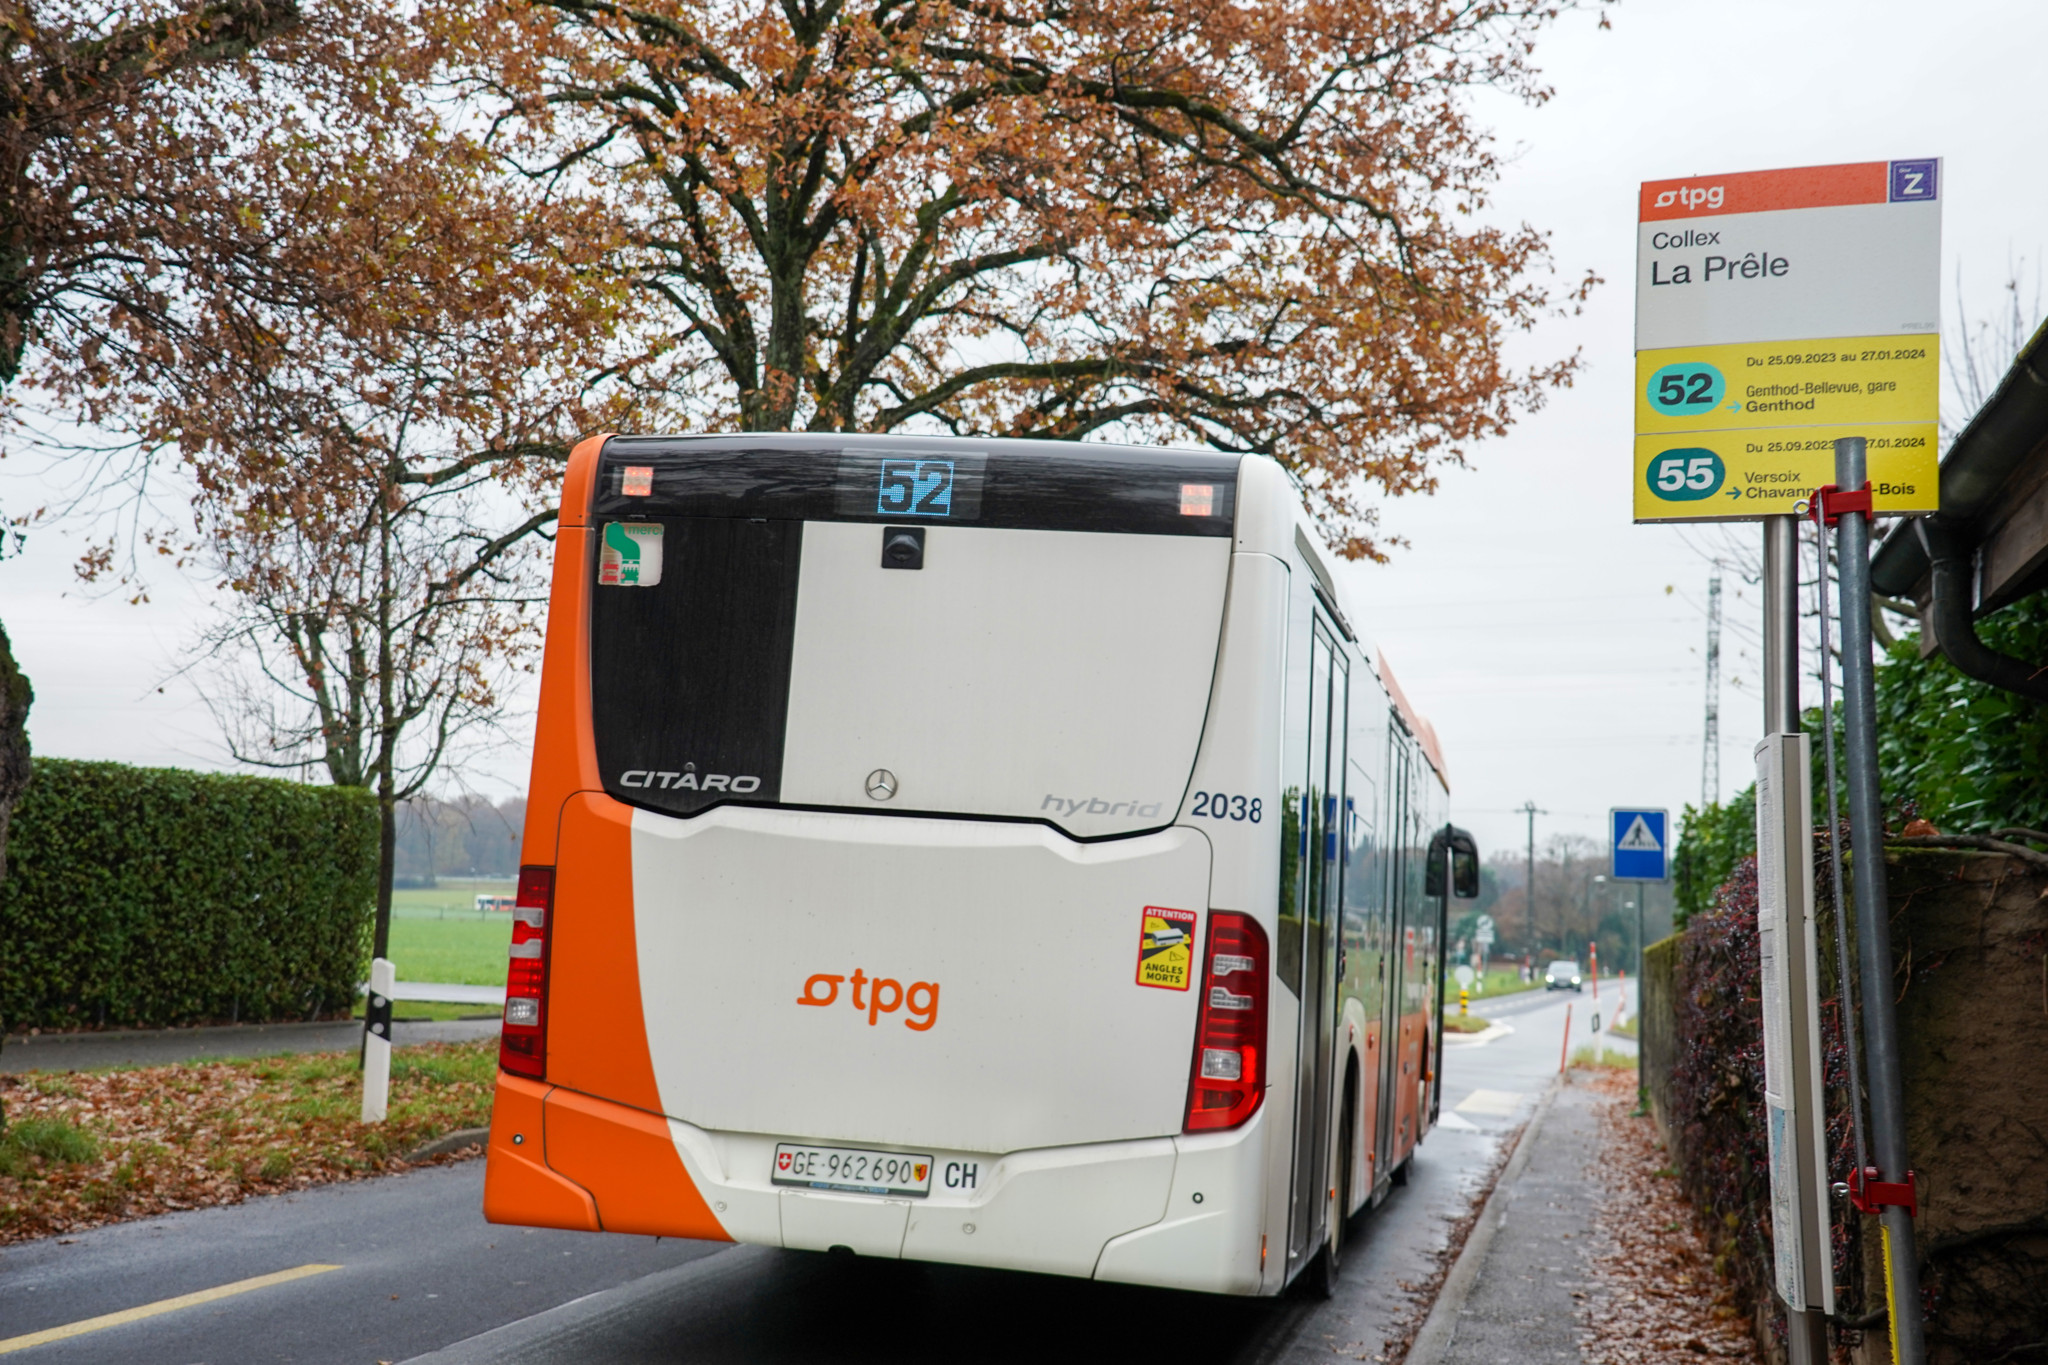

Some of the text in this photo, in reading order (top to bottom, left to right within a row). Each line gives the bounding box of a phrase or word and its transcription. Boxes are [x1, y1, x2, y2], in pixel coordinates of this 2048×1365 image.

[1903, 172, 1924, 195] Z
[1652, 230, 1720, 250] Collex
[1652, 252, 1789, 286] La Prêle
[1747, 349, 1926, 367] Du 25.09.2023 au 27.01.2024
[1658, 372, 1713, 406] 52
[1746, 381, 1896, 398] Genthod-Bellevue, gare
[1746, 398, 1815, 413] Genthod
[1746, 443, 1763, 453] Du
[1768, 440, 1835, 452] 25.09.2023
[1657, 457, 1715, 491] 55
[1745, 470, 1801, 483] Versoix
[878, 460, 953, 515] 52
[620, 770, 761, 793] CITARO
[1040, 794, 1163, 818] hybrid
[1192, 791, 1263, 823] 2038
[1145, 908, 1194, 921] ATTENTION
[1145, 963, 1183, 975] ANGLES
[1146, 972, 1181, 983] MORTS
[945, 1162, 978, 1189] CH
